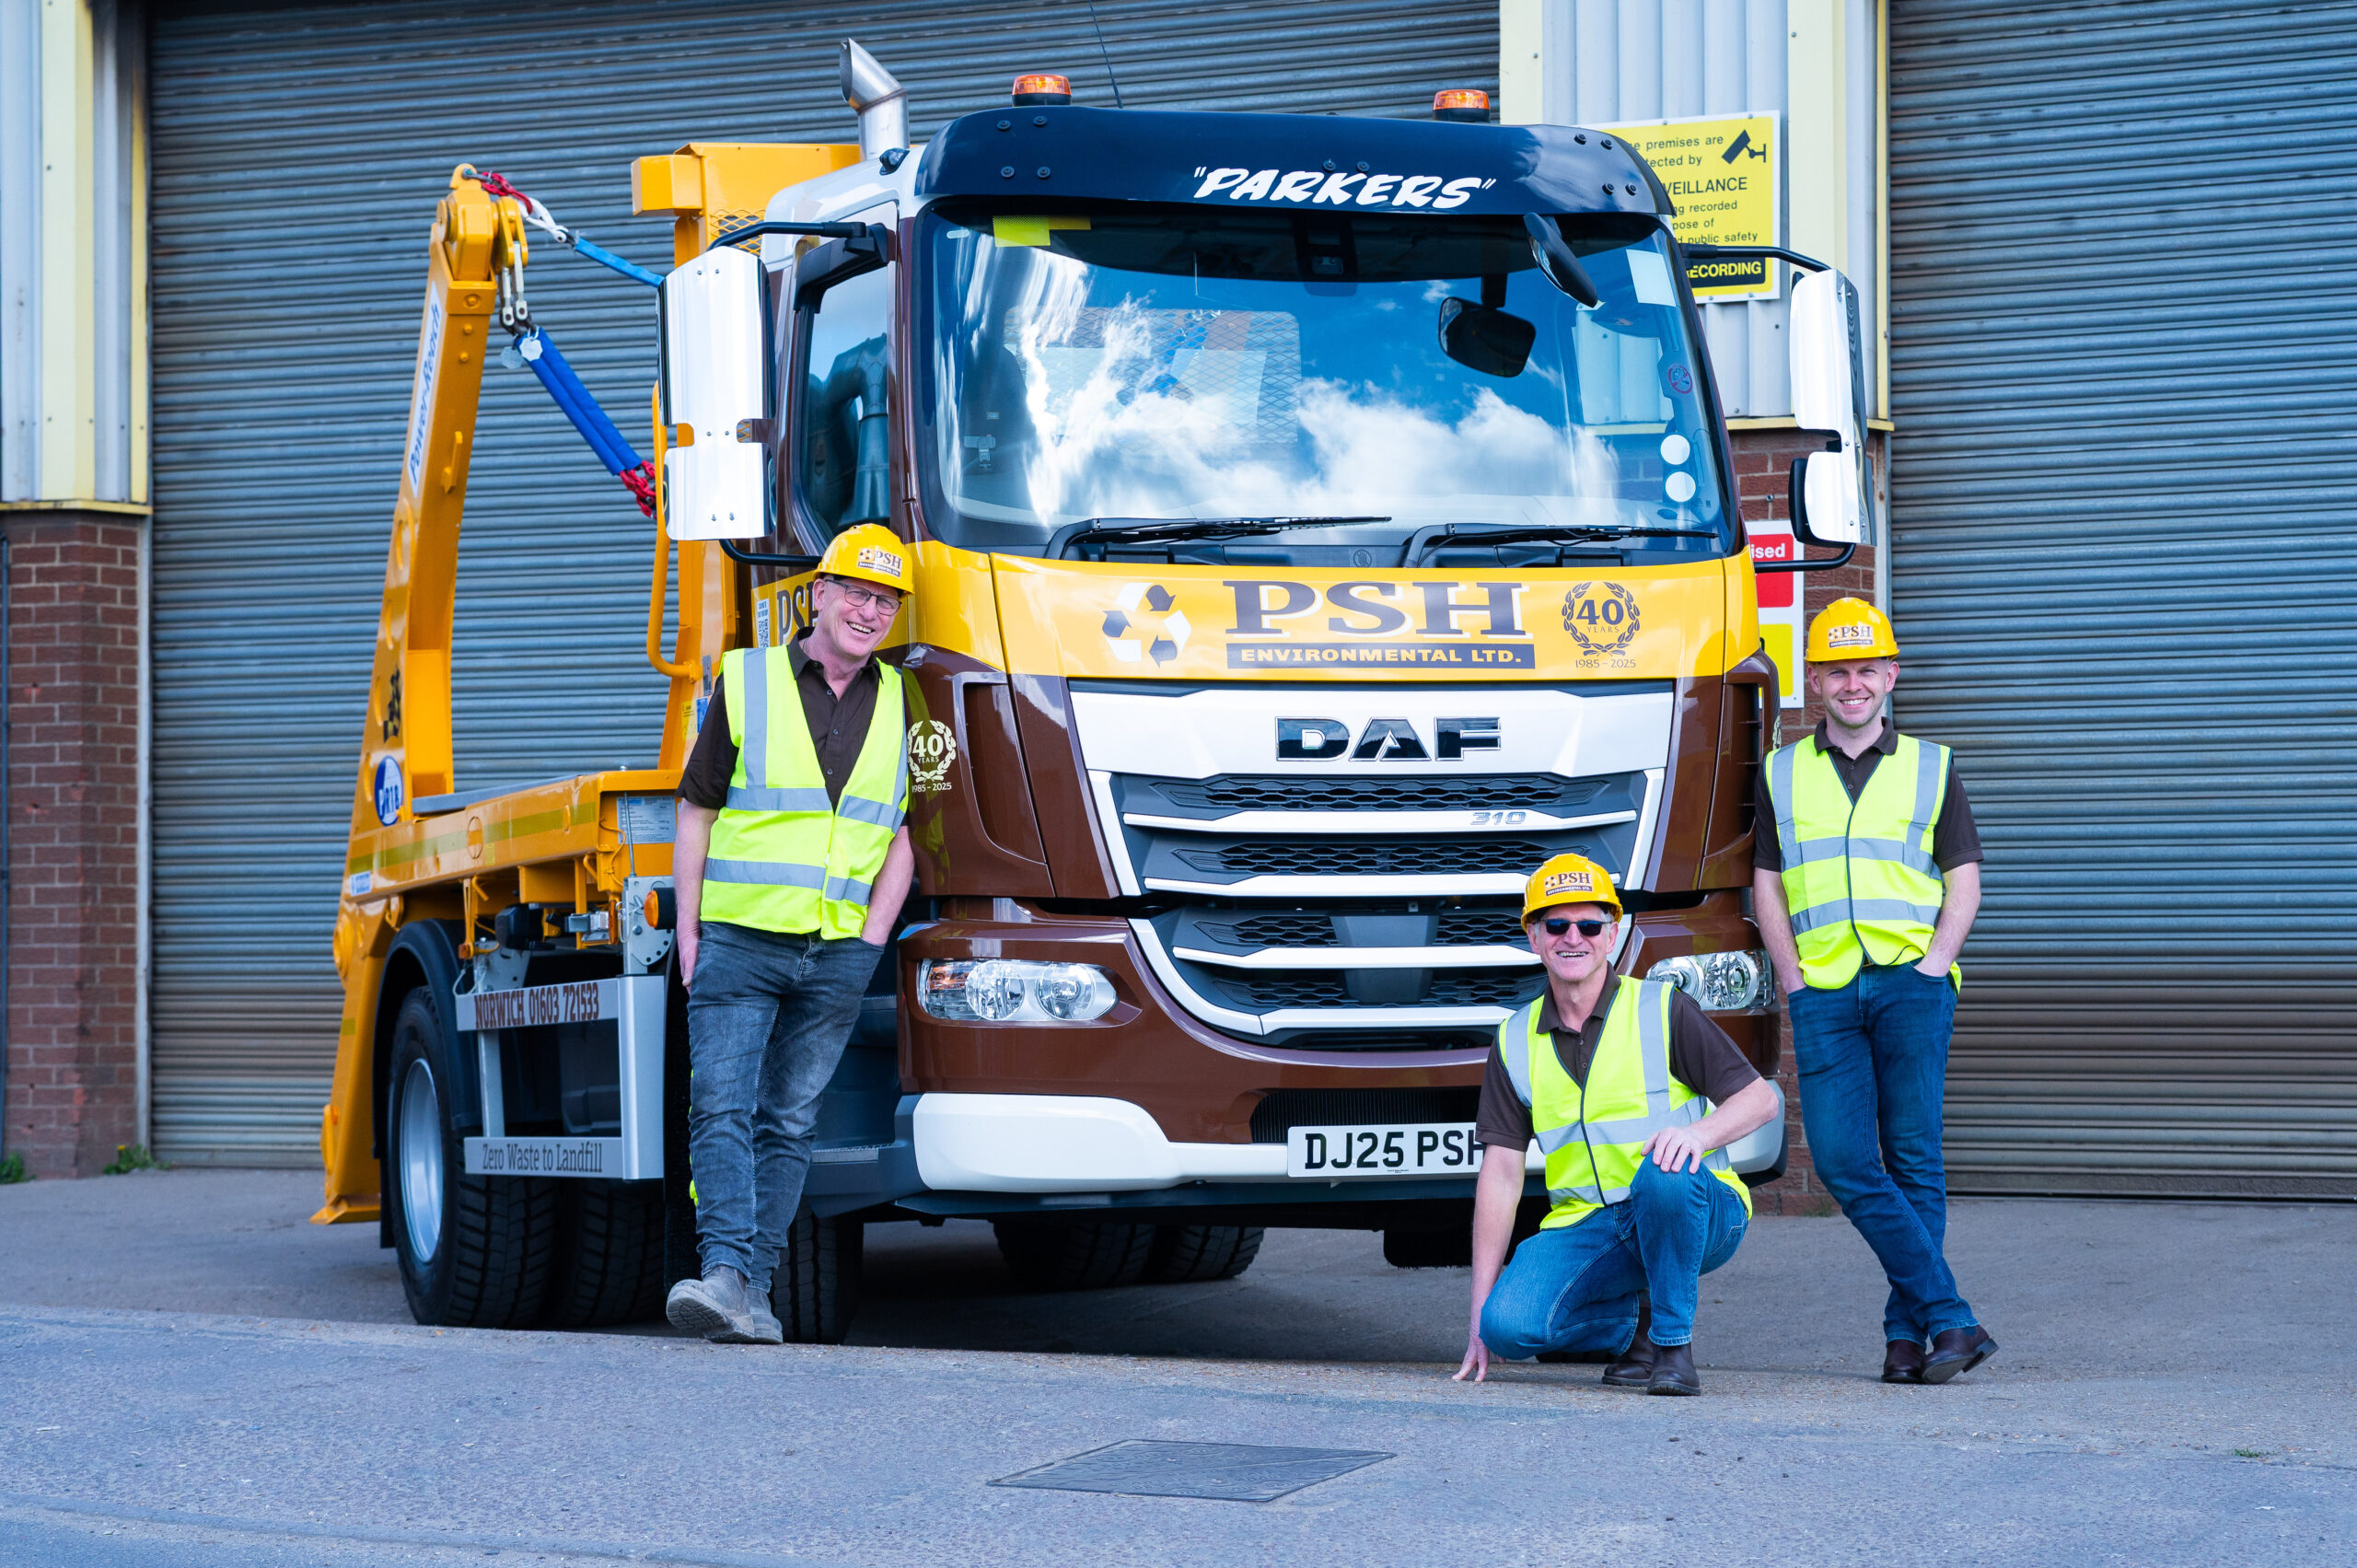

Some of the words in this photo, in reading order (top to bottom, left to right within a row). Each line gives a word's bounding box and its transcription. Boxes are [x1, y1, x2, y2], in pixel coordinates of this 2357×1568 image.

[1646, 136, 1700, 153] premises
[1705, 134, 1724, 145] are
[1645, 156, 1683, 168] ected
[1689, 155, 1702, 167] by
[1664, 177, 1747, 195] VEILLANCE
[1689, 200, 1737, 214] recorded
[1672, 219, 1699, 231] pose
[1703, 218, 1714, 228] of
[1688, 232, 1720, 245] public
[1724, 231, 1758, 243] safety
[1751, 542, 1785, 559] ised
[874, 550, 902, 569] PSH
[1223, 580, 1534, 639] PSH
[1576, 598, 1624, 626] 40
[1840, 625, 1872, 638] PSH
[1241, 647, 1462, 663] ENVIRONMENTAL
[1471, 648, 1522, 663] LTD.
[1574, 658, 1600, 668] 1985
[1610, 658, 1636, 668] 2025
[911, 734, 944, 758] 40
[1274, 715, 1502, 762] DAF
[917, 756, 940, 764] YEARS
[911, 784, 926, 793] 1985
[932, 782, 952, 792] 2025
[1469, 811, 1527, 826] 310
[1558, 872, 1591, 886] PSH
[474, 990, 525, 1029] NORWICH
[528, 986, 560, 1025] 01603
[563, 981, 599, 1022] 721533
[482, 1143, 505, 1170] Zero
[506, 1144, 540, 1171] Waste
[542, 1145, 553, 1171] to
[556, 1141, 603, 1173] Landfill
[1305, 1131, 1404, 1169] DJ25
